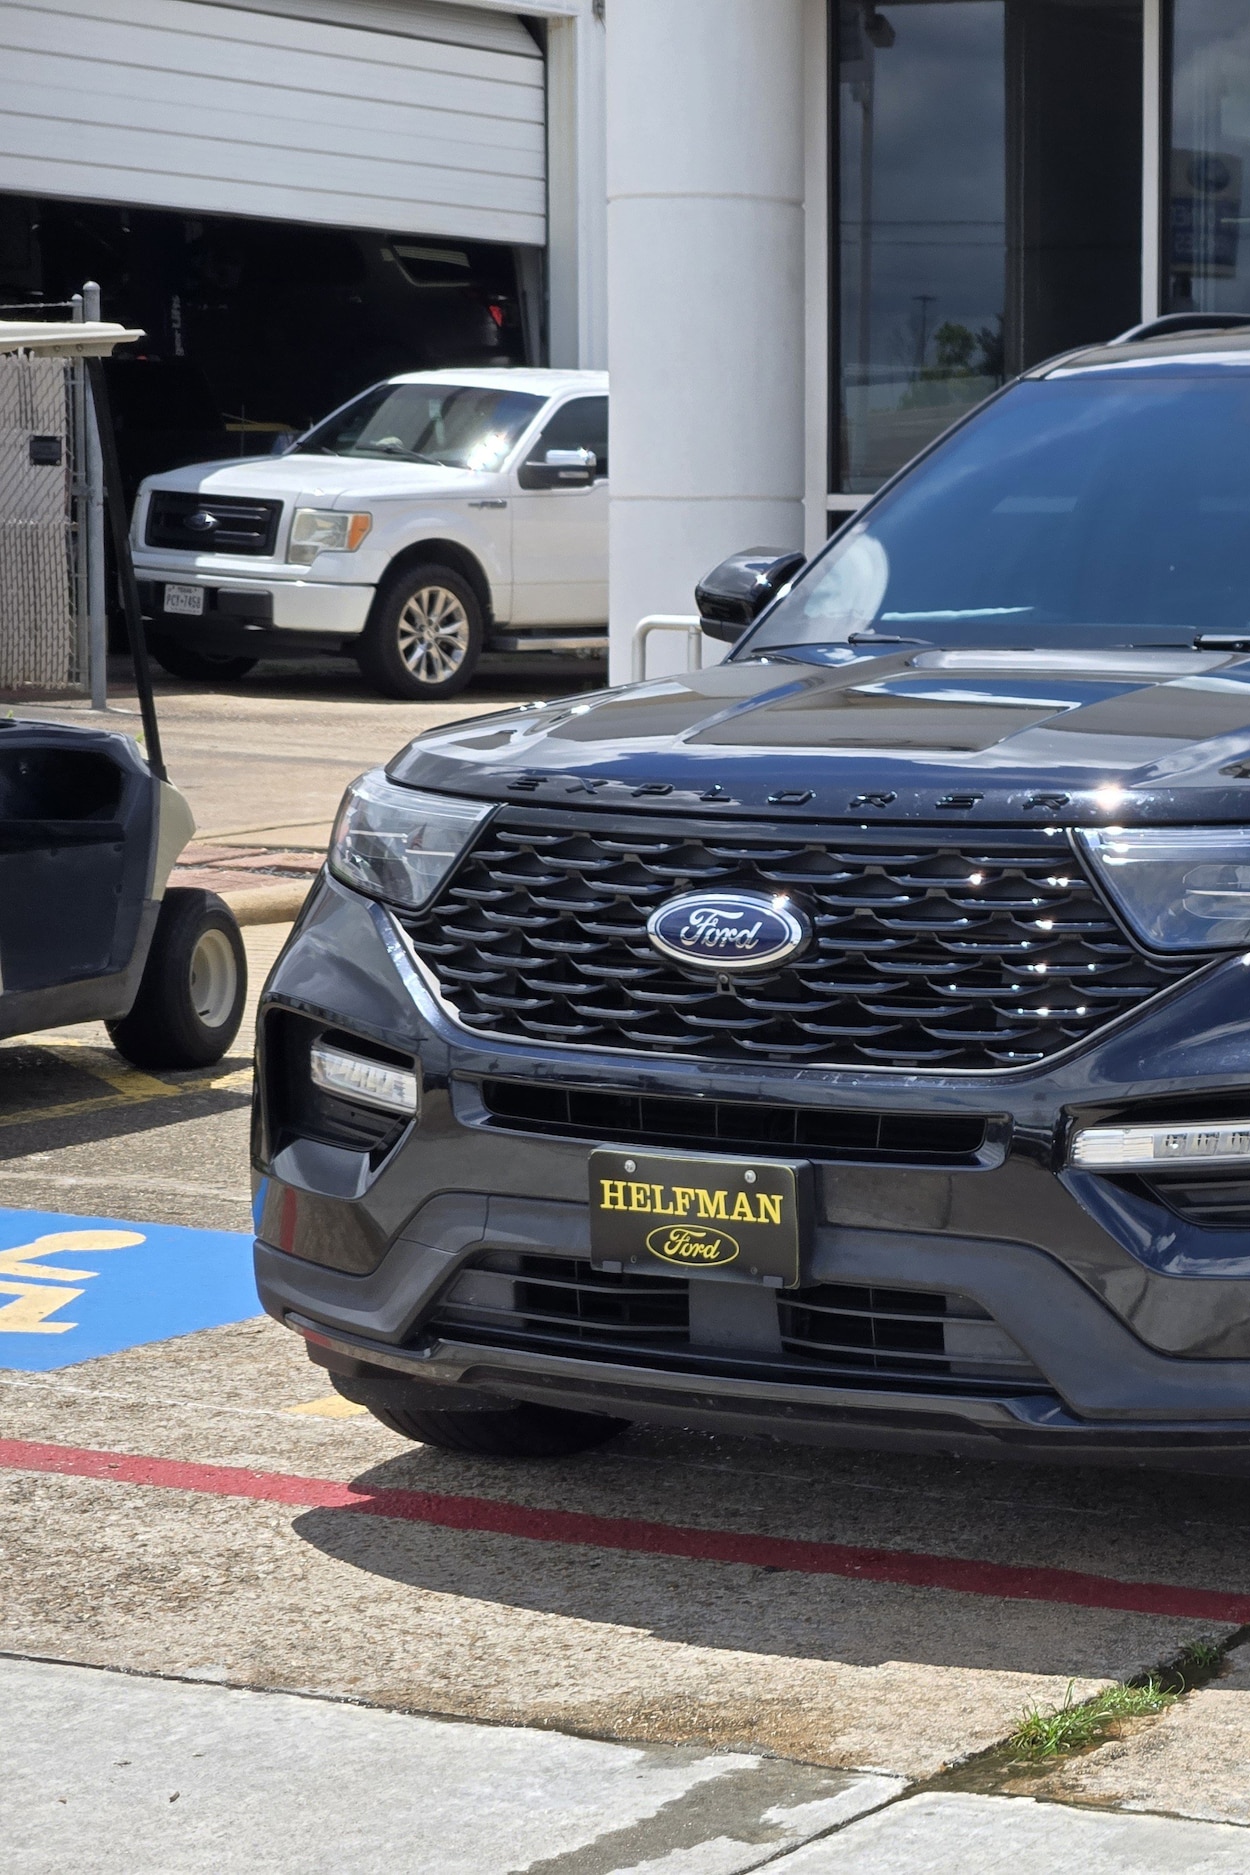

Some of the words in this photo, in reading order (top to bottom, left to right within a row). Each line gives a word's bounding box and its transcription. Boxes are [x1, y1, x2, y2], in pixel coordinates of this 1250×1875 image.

[507, 776, 1071, 810] EXPLORER
[680, 907, 763, 950] Ford
[600, 1179, 783, 1224] HELFMAN
[663, 1228, 721, 1260] Ford
